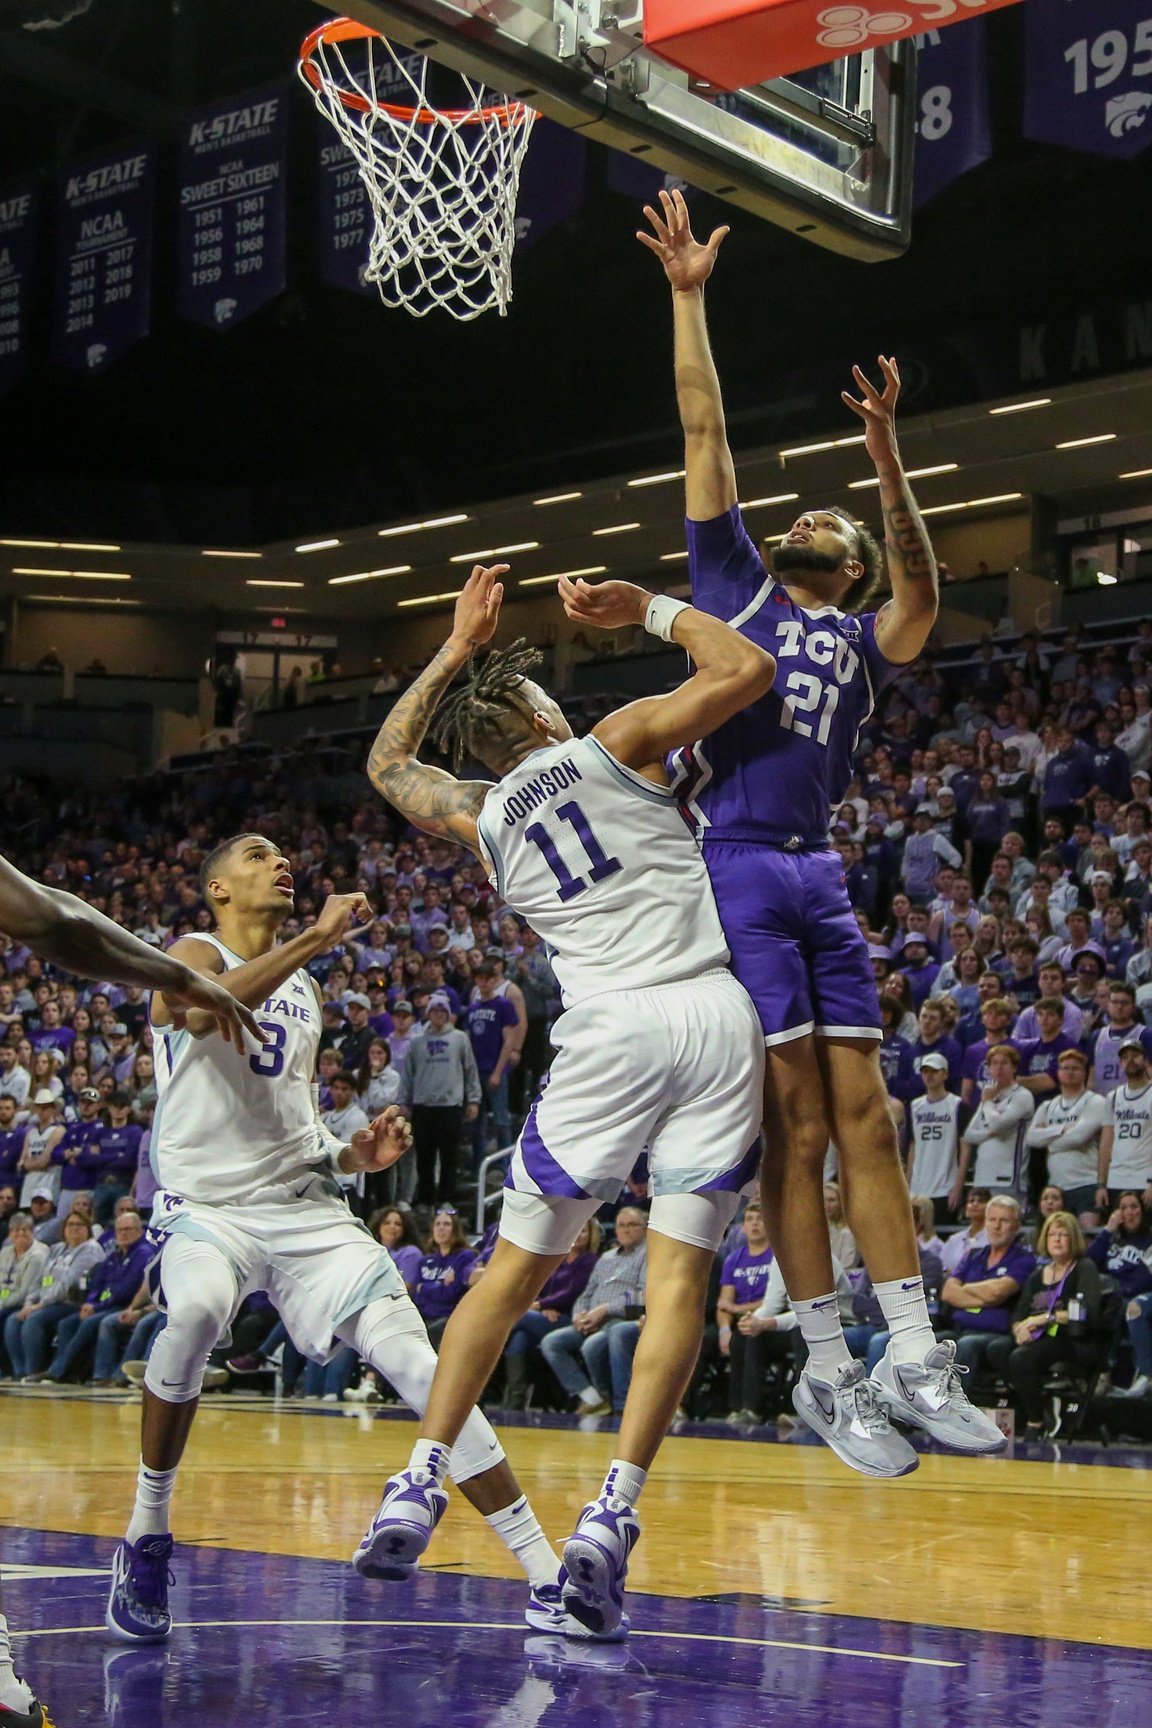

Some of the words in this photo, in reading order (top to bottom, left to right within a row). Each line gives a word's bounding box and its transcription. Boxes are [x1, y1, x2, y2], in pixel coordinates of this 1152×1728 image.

[188, 98, 279, 146] K-STATE
[65, 154, 147, 200] K-STATE
[180, 177, 226, 204] SWEET
[227, 161, 279, 192] SIXTEEN
[219, 160, 244, 175] NCAA
[195, 207, 223, 227] 1951
[236, 195, 265, 215] 1961
[334, 187, 365, 208] 1973
[81, 210, 125, 240] NCAA
[194, 226, 223, 247] 1956
[236, 214, 265, 236] 1964
[333, 207, 365, 229] 1975
[332, 228, 364, 249] 1977
[70, 257, 95, 277] 2011
[106, 245, 135, 266] 2017
[191, 266, 222, 286] 1959
[233, 254, 263, 276] 1970
[67, 294, 94, 314] 2013
[104, 283, 132, 303] 2019
[66, 313, 93, 333] 2014
[775, 621, 860, 685] TCU
[780, 671, 840, 746] 21
[503, 758, 583, 826] JOHNSON
[524, 800, 624, 903] 11
[258, 997, 311, 1023] TATE
[250, 1021, 286, 1077] 3
[1103, 1063, 1120, 1080] 21
[916, 1111, 952, 1124] Wildcats
[921, 1125, 943, 1141] 25
[1119, 1122, 1142, 1140] 20
